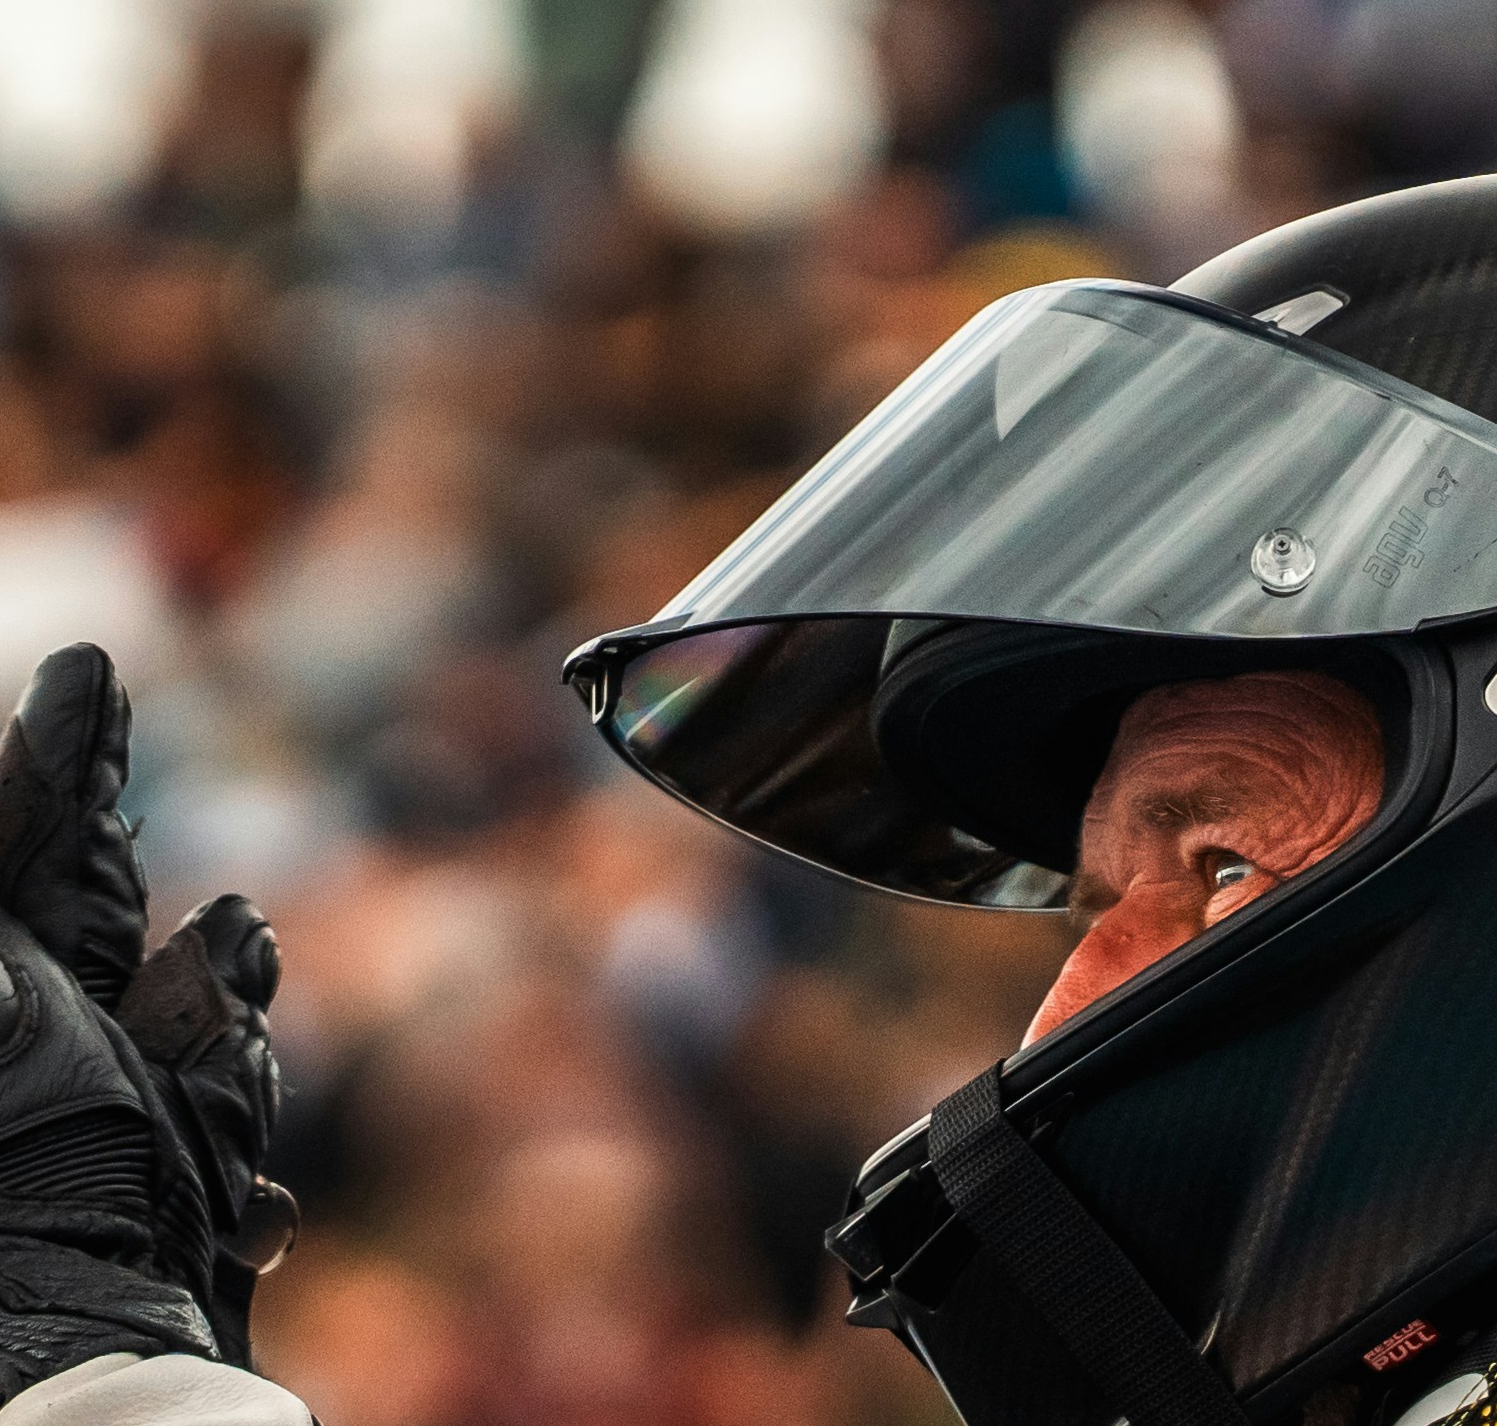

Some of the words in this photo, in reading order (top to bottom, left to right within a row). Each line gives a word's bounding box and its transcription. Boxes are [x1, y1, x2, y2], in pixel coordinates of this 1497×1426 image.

[1362, 506, 1429, 589] agv
[1363, 1318, 1424, 1361] RESCUE
[1371, 1331, 1437, 1371] PULL
